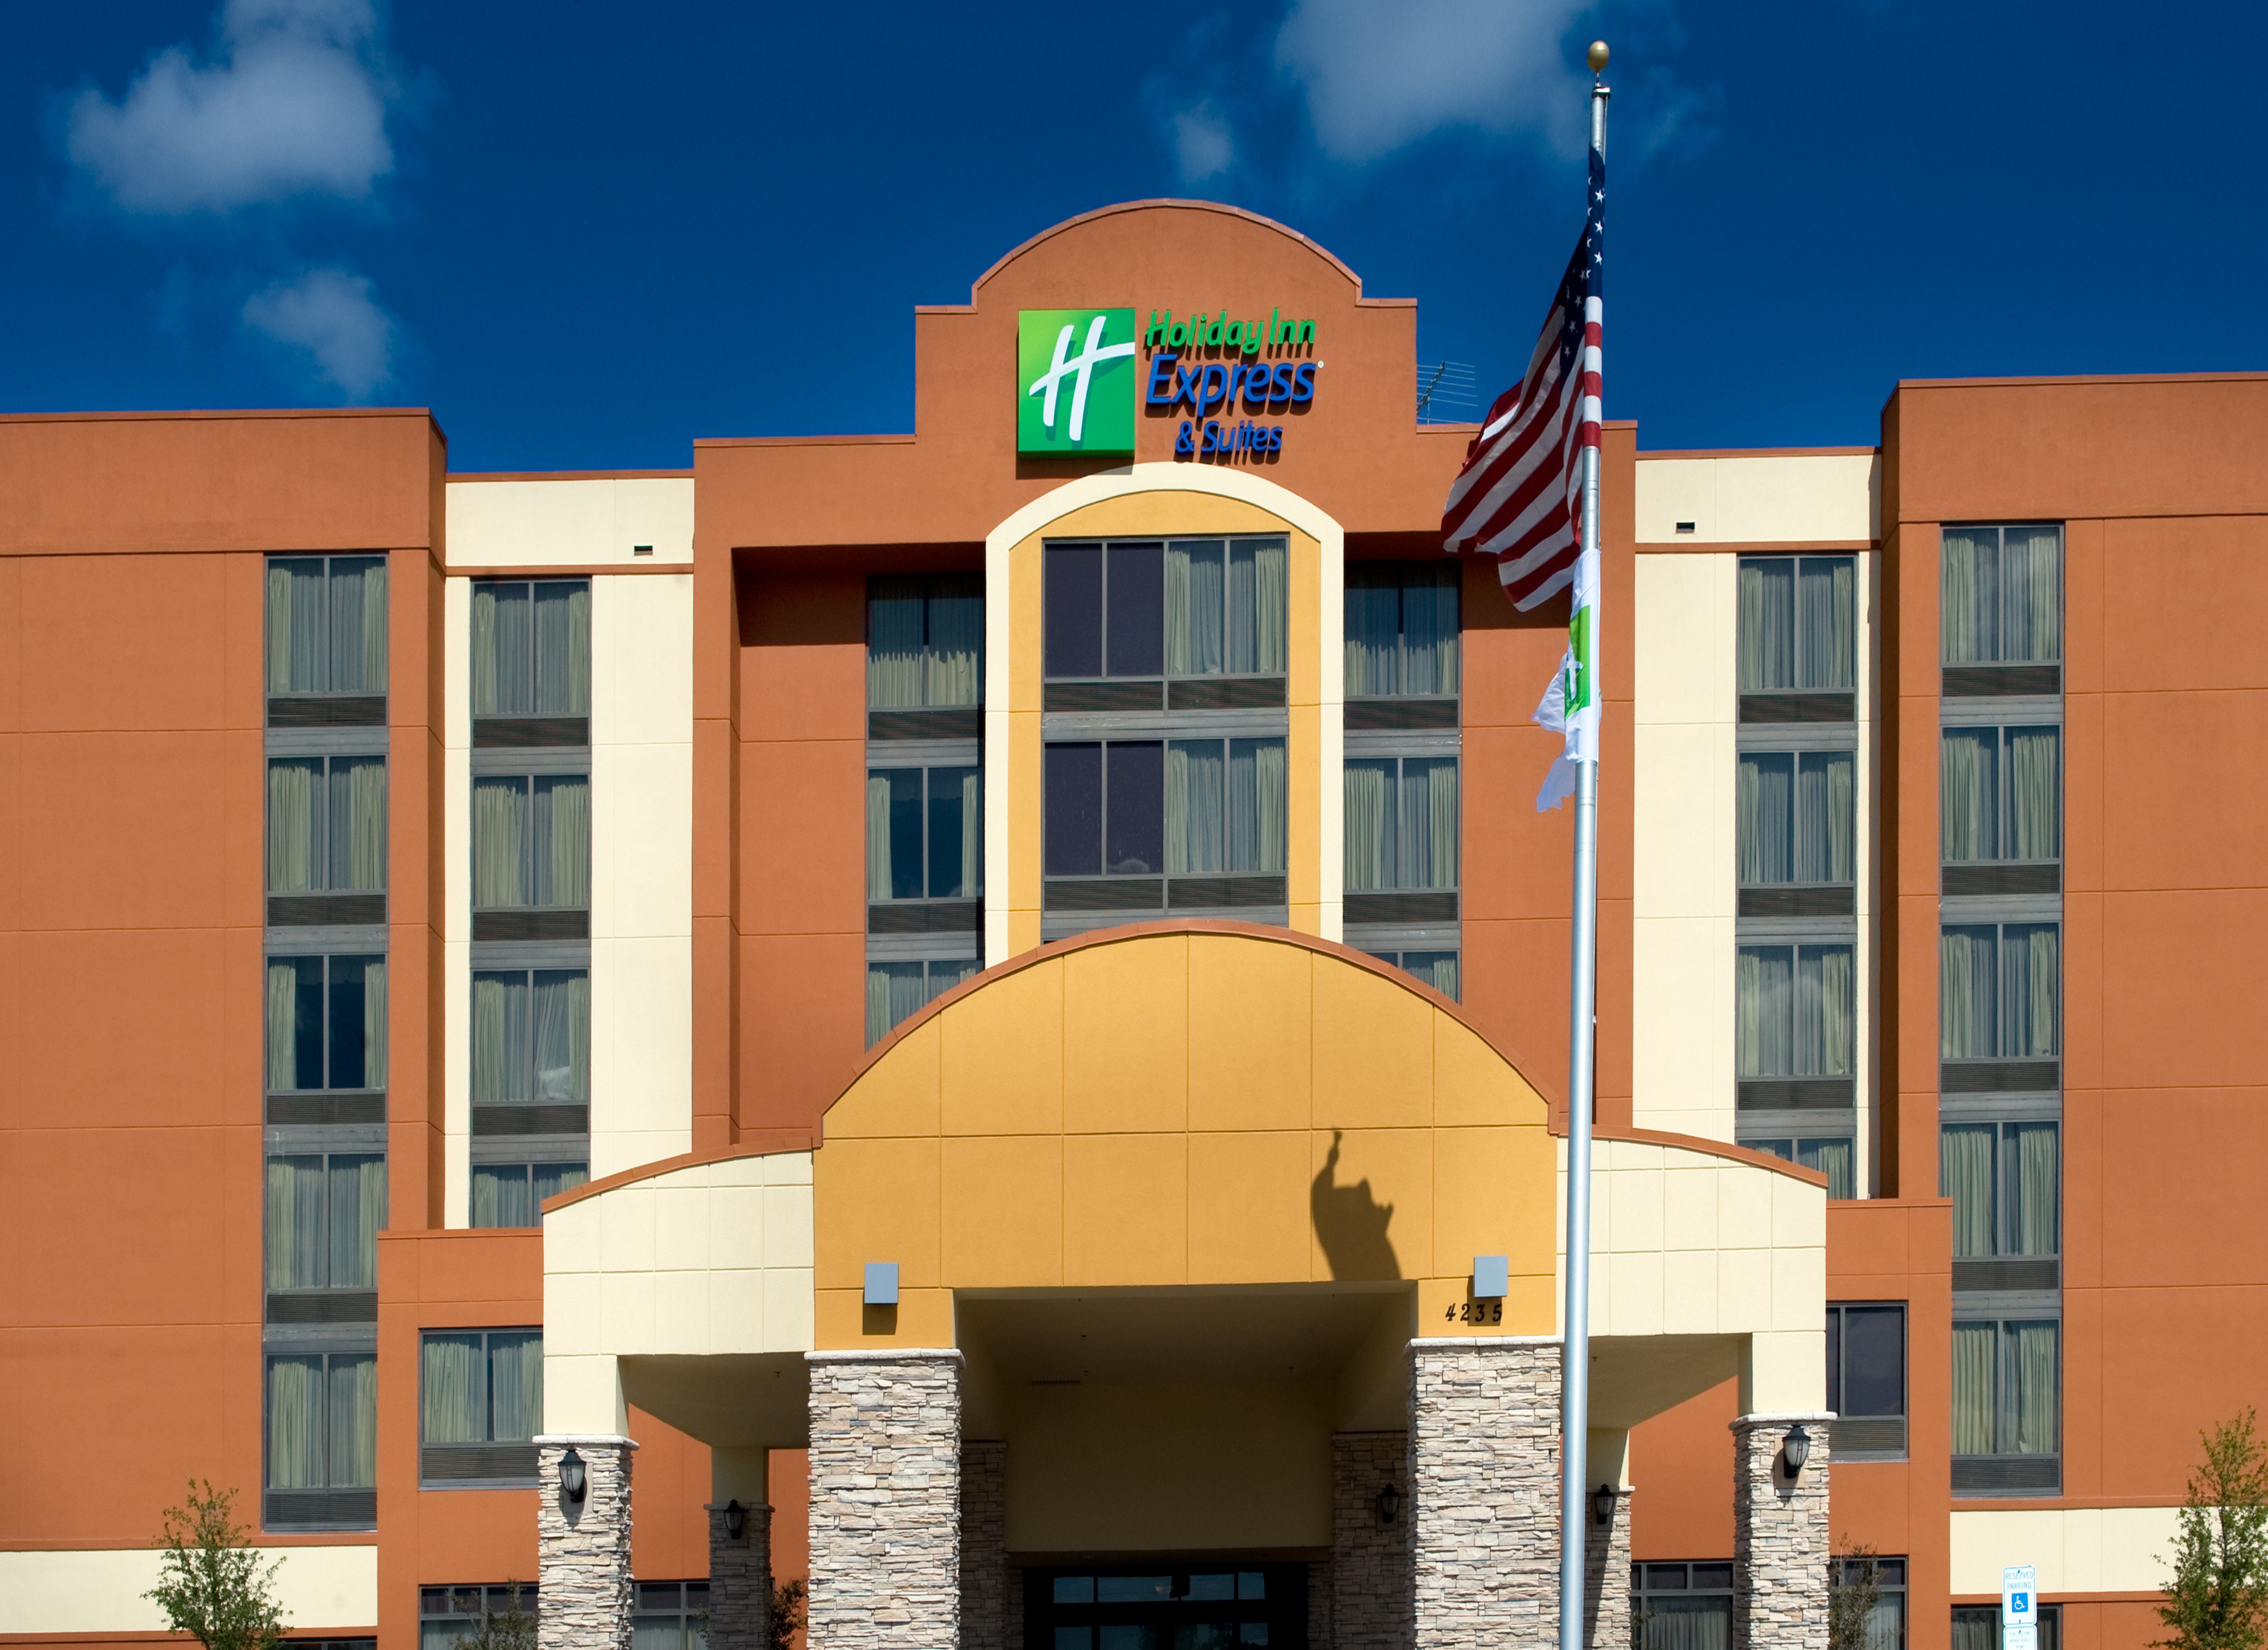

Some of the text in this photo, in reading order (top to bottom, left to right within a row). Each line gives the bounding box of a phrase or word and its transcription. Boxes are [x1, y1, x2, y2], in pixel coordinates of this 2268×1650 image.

[1145, 308, 1317, 354] Holiday Inn
[1145, 354, 1317, 417] Express
[1175, 420, 1283, 453] & Suites
[1445, 1303, 1502, 1322] 4235
[2005, 1571, 2033, 1580] RESERVED
[2007, 1581, 2032, 1590] PARKING
